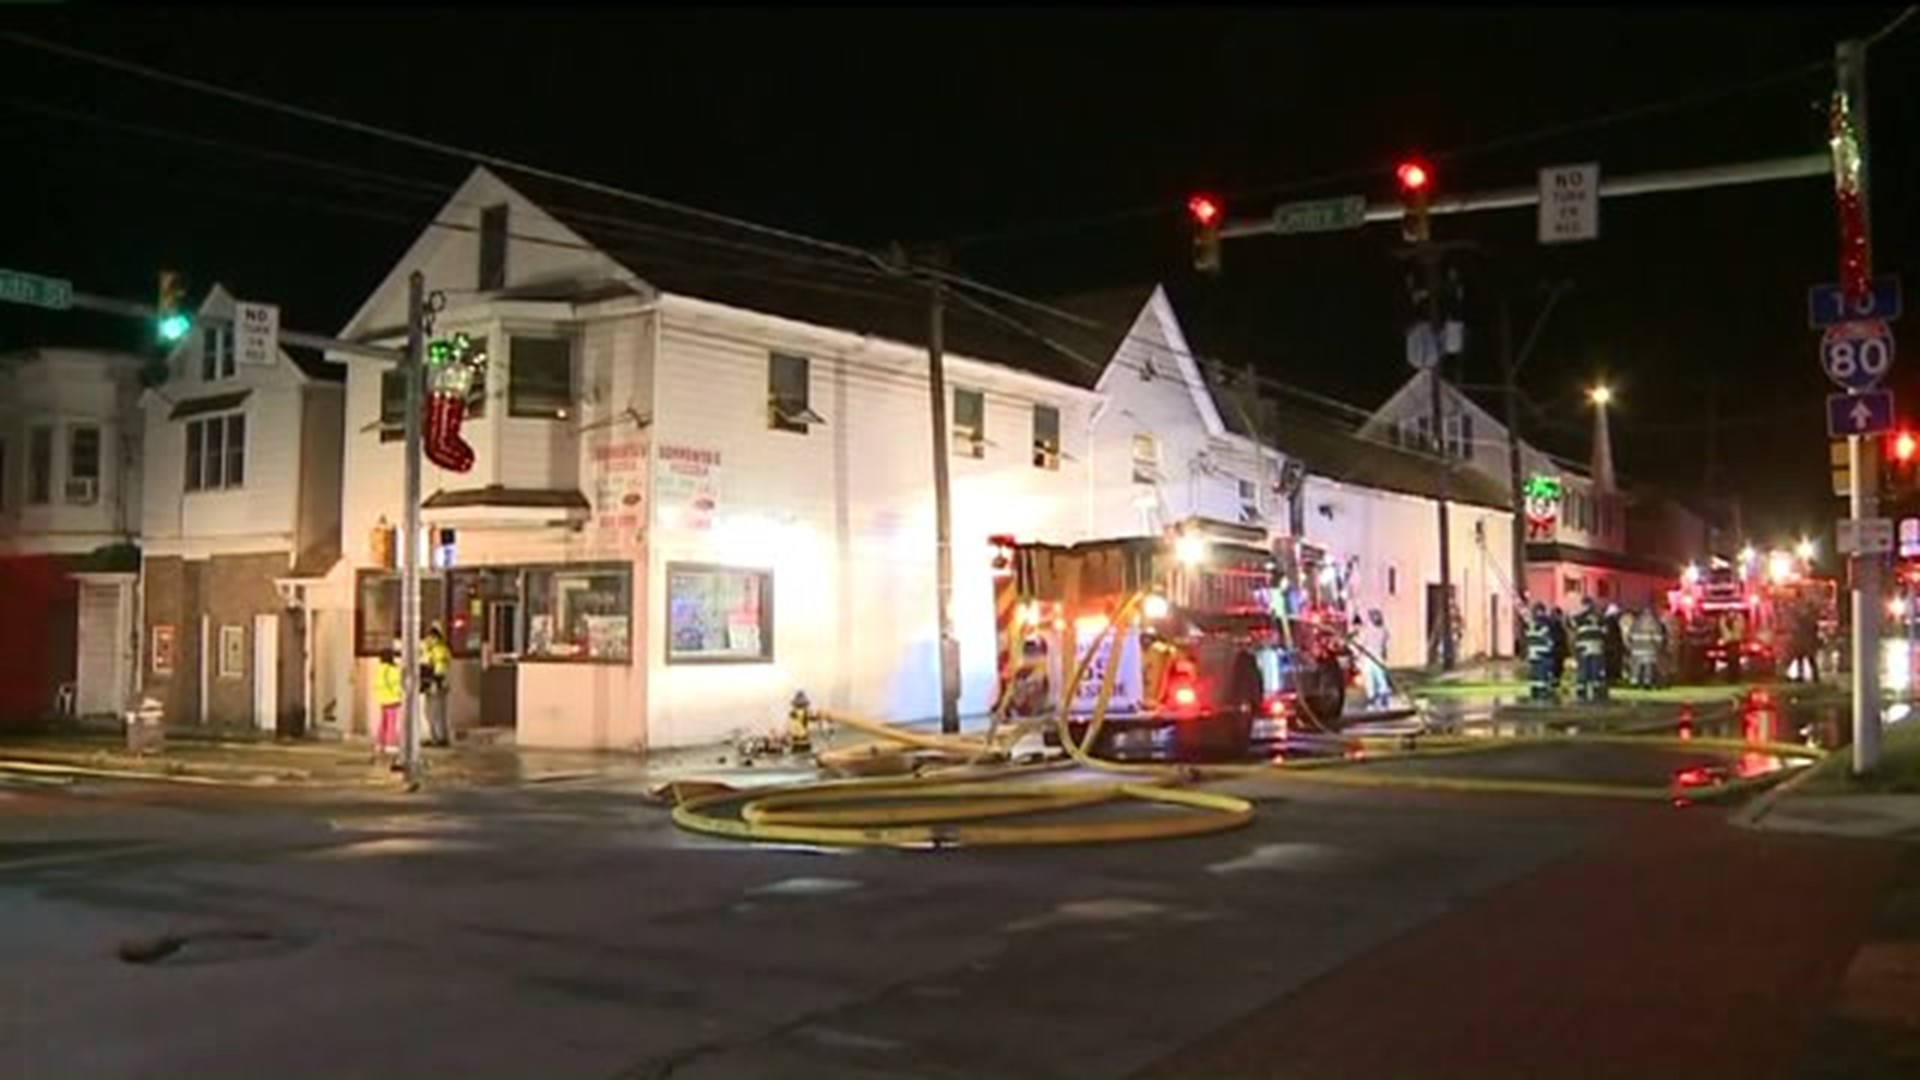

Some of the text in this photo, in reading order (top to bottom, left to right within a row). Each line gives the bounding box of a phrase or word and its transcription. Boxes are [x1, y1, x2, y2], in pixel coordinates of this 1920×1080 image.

[1555, 172, 1584, 190] NO
[244, 308, 270, 322] NO
[1830, 339, 1888, 378] 80
